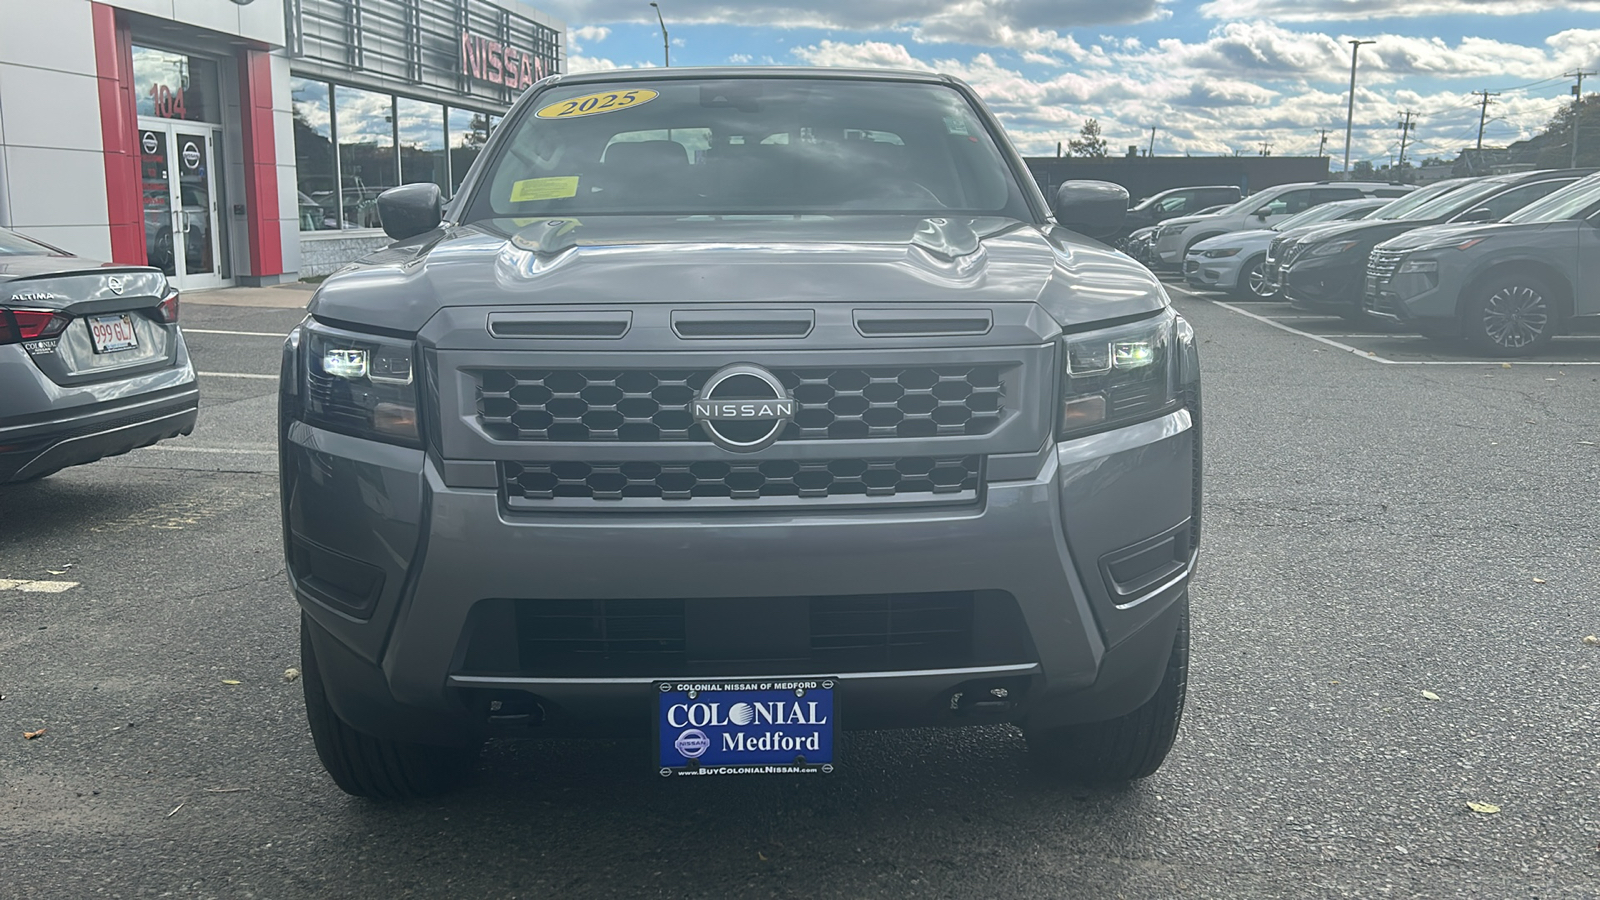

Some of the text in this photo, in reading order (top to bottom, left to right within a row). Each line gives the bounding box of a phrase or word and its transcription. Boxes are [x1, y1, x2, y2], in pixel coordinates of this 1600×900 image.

[462, 31, 548, 90] NISSAN
[149, 83, 187, 119] 104
[557, 91, 639, 116] 2025
[11, 293, 54, 301] ALTIMA
[93, 324, 113, 343] 999
[25, 341, 57, 350] COLONIAL
[696, 403, 792, 417] NISSAN
[677, 683, 722, 691] COLONIAL
[774, 681, 817, 689] MEDFORD
[667, 701, 827, 728] COLONIAL
[722, 731, 819, 752] Medford
